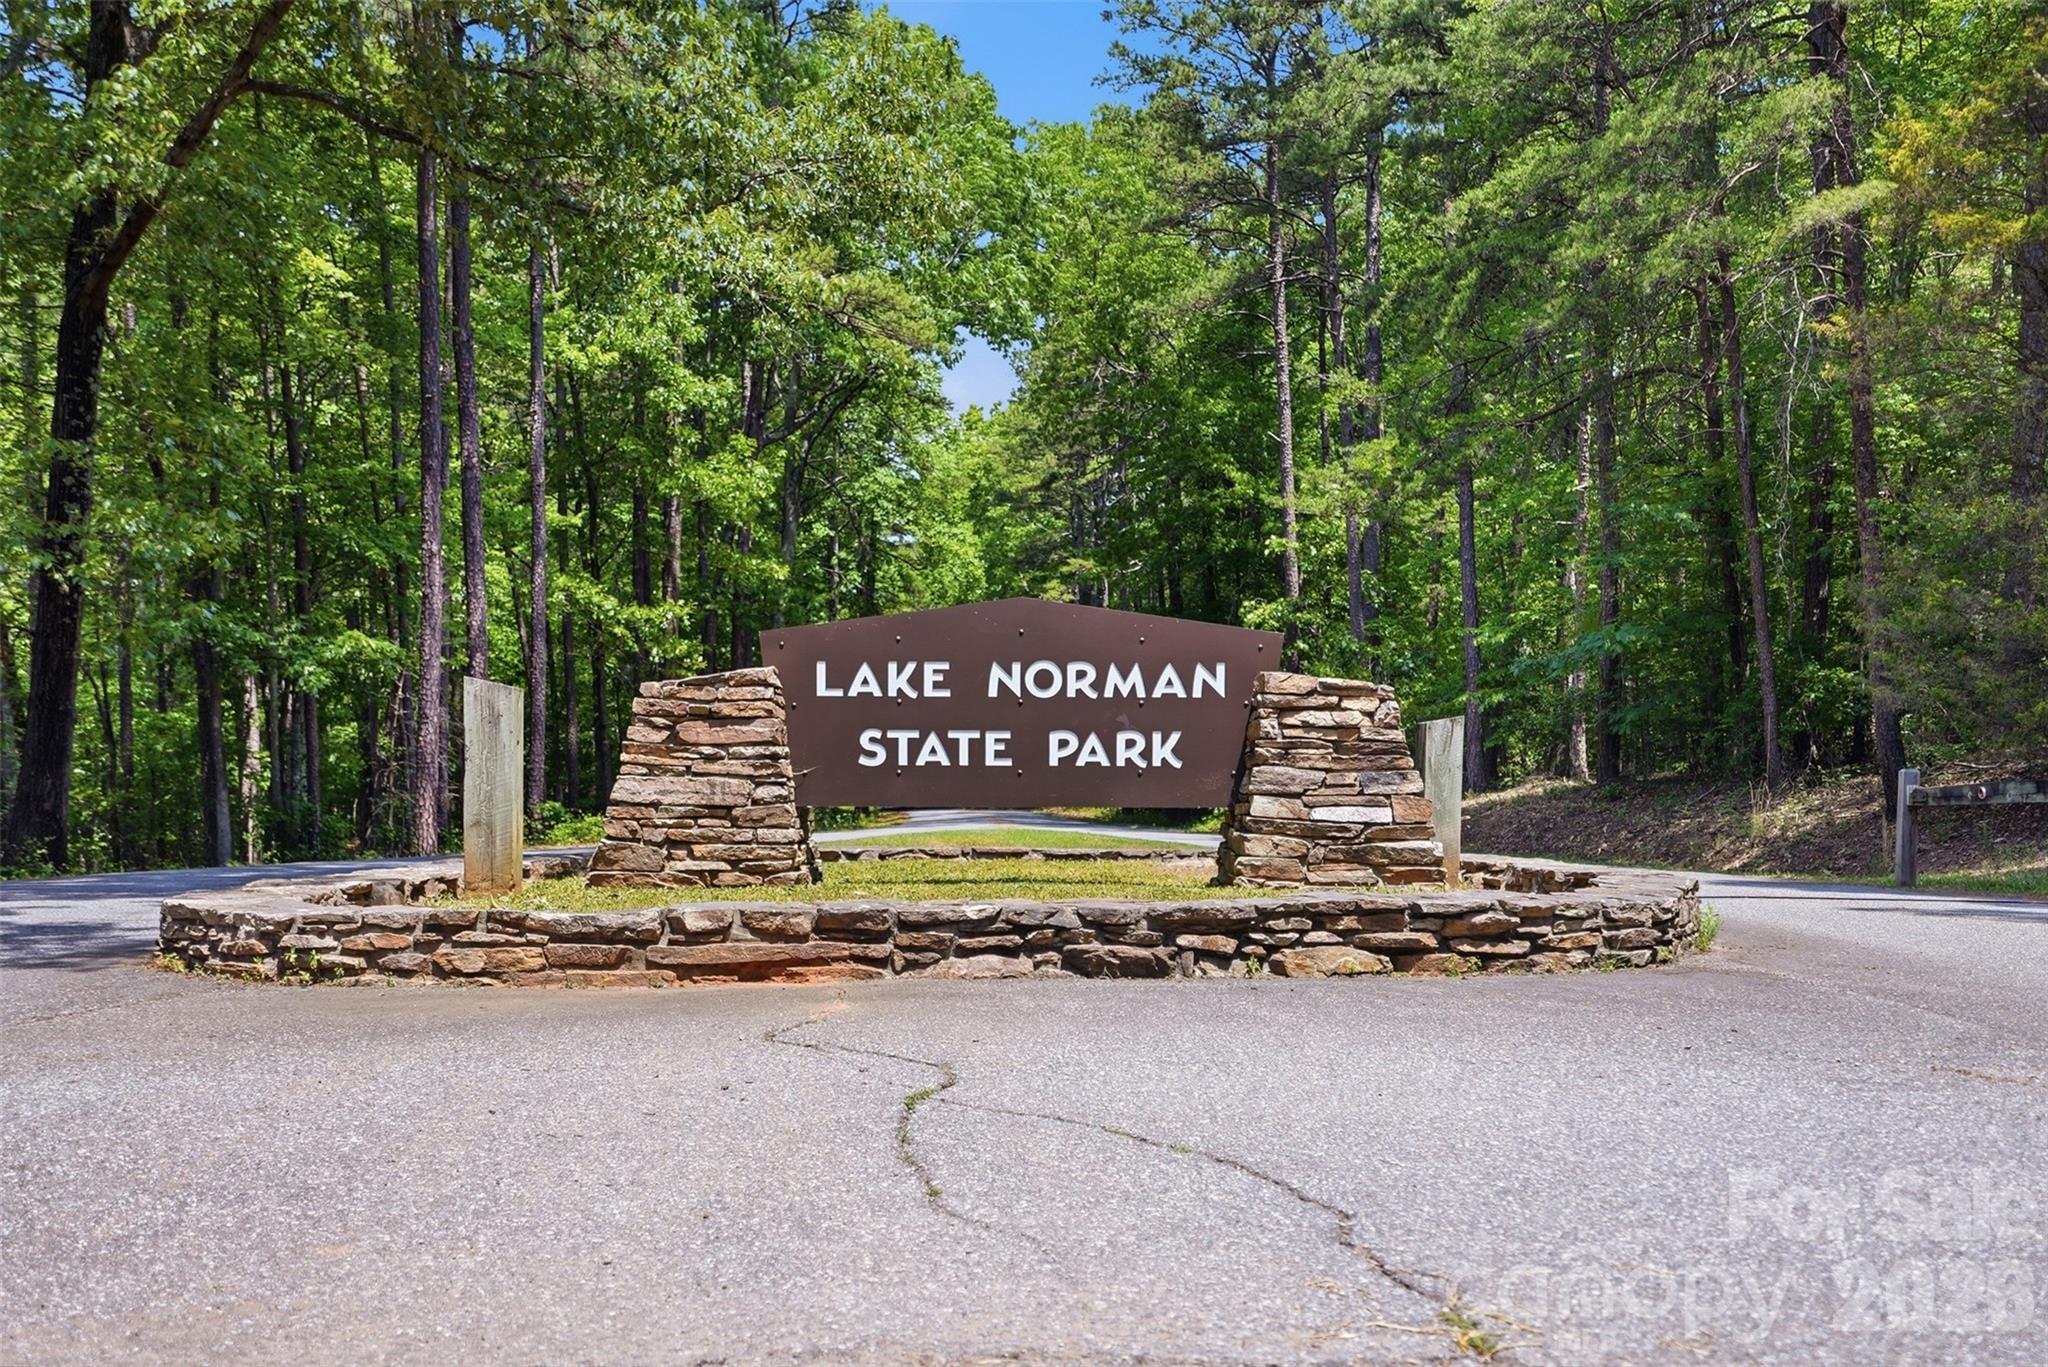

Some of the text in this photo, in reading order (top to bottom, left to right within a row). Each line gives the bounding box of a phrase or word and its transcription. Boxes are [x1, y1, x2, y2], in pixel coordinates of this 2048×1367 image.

[815, 660, 1227, 700] LAKE NORMAN
[857, 728, 1184, 769] STATE PARK
